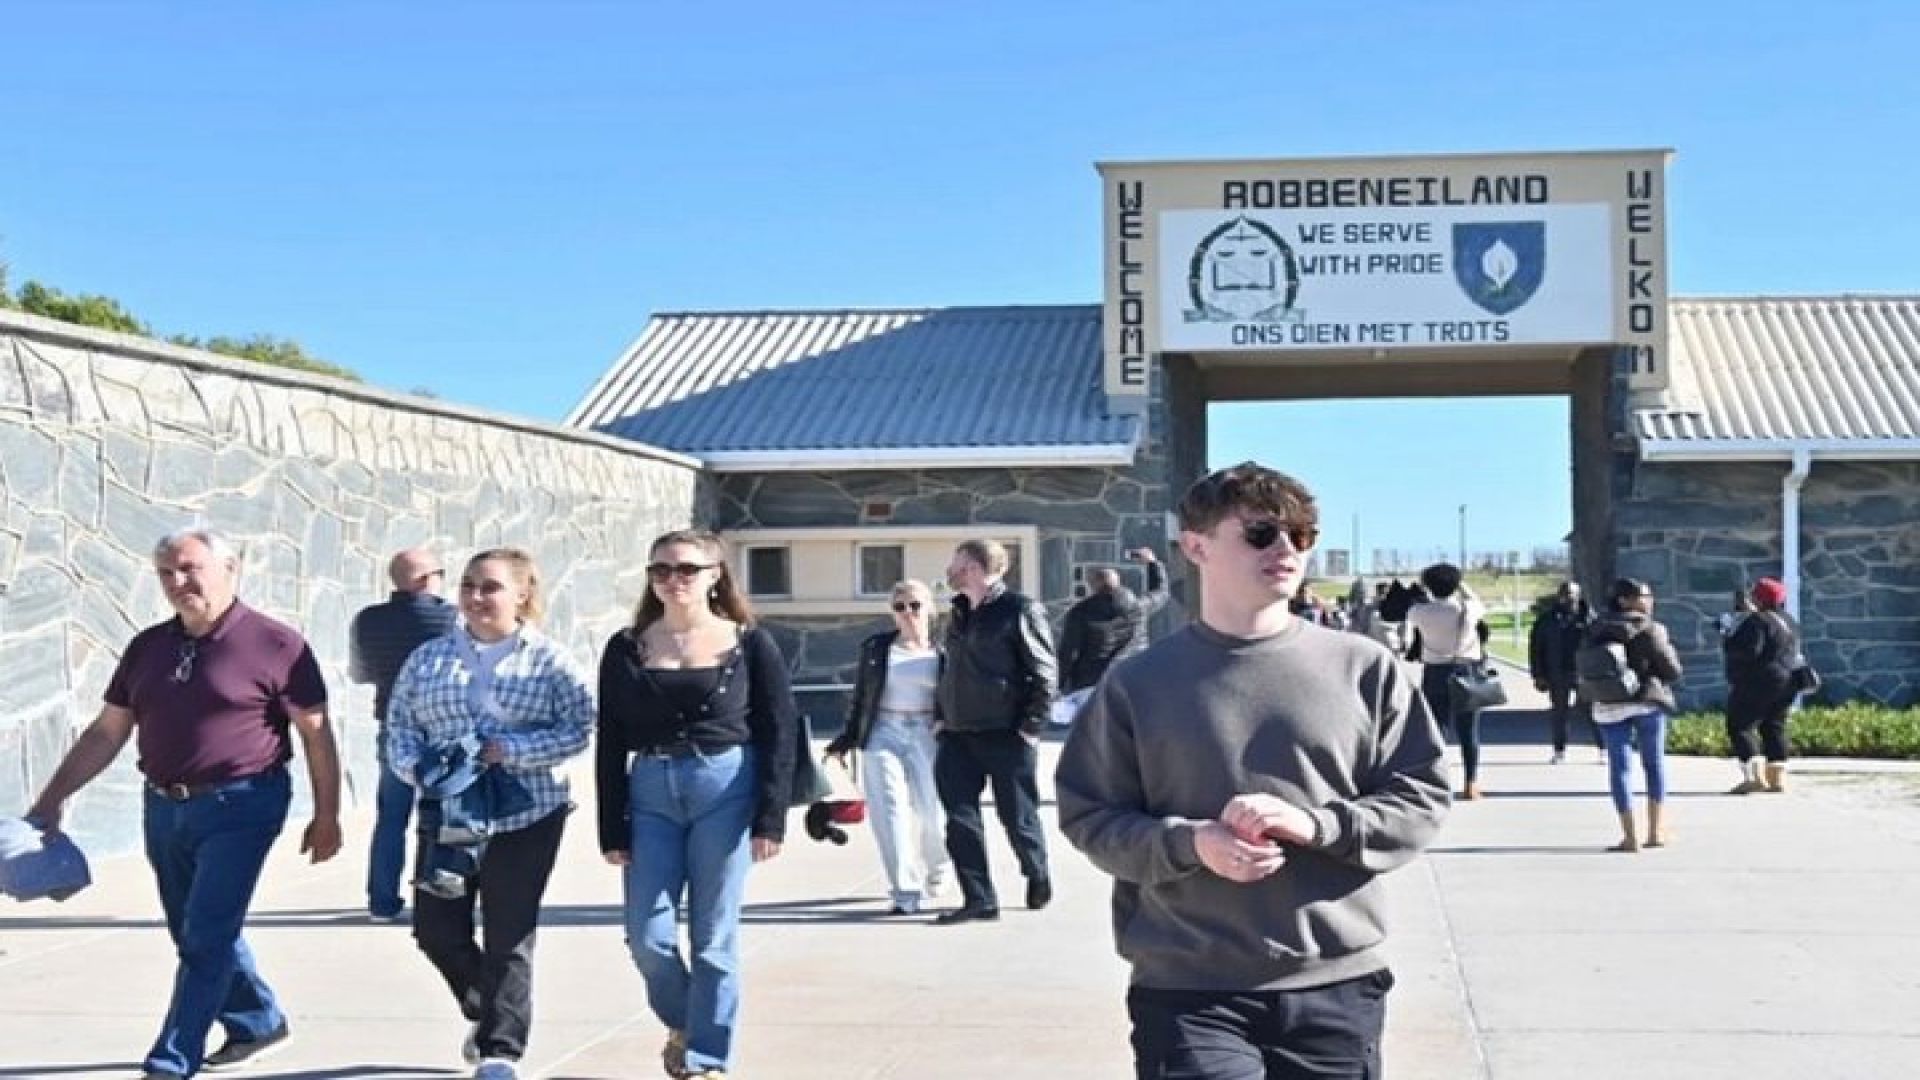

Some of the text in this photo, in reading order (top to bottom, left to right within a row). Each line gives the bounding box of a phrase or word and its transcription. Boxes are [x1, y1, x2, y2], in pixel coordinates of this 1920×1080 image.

[1223, 174, 1549, 209] ROBBENEILAND
[1298, 221, 1432, 244] WE SERVE
[1298, 251, 1443, 275] WITH PRIDE
[1626, 170, 1654, 374] WELKOM
[1118, 181, 1145, 386] WELCOME
[1231, 319, 1509, 344] ONS DIEN MET TROTS
